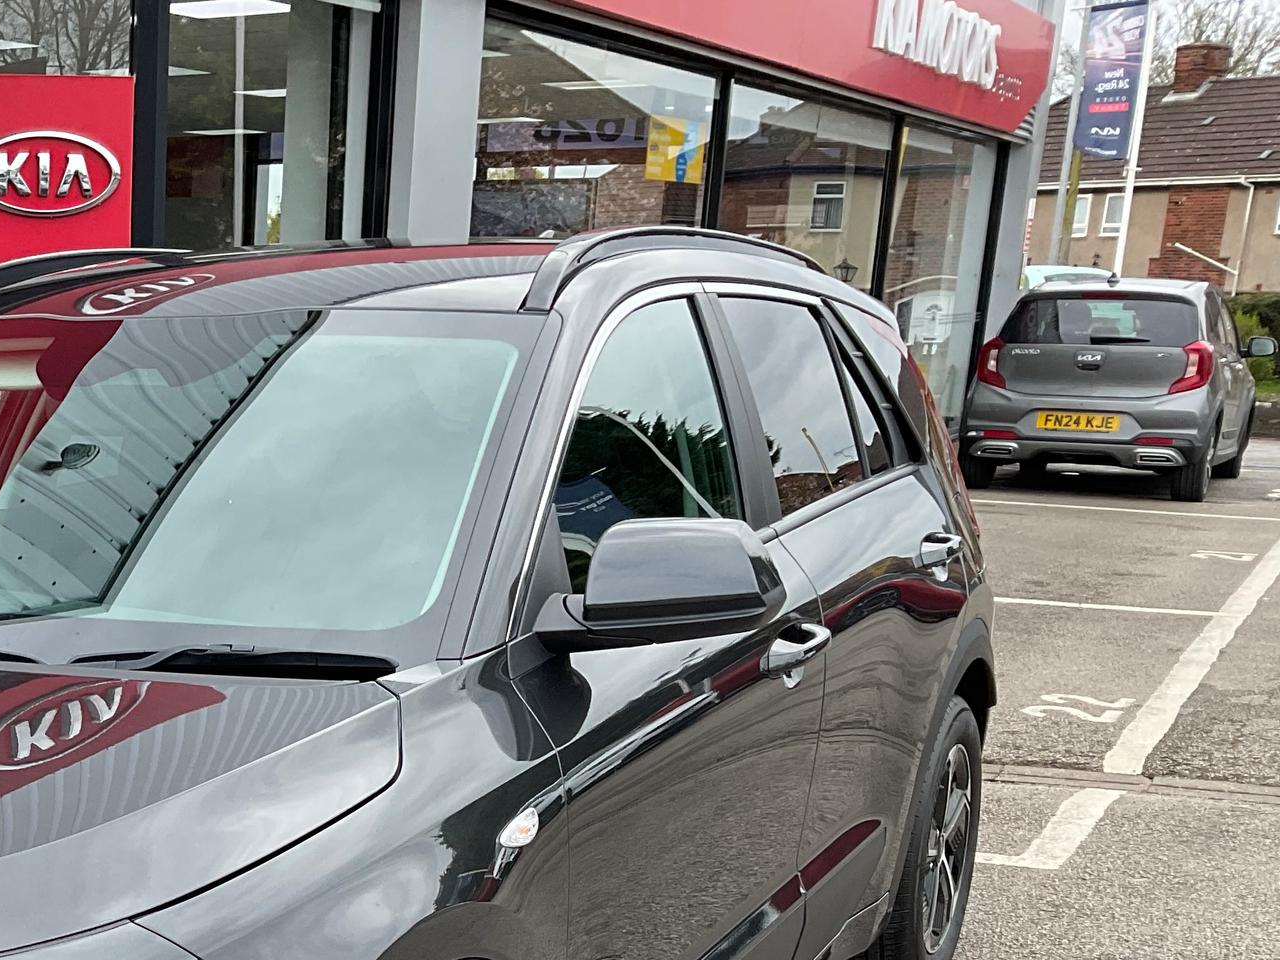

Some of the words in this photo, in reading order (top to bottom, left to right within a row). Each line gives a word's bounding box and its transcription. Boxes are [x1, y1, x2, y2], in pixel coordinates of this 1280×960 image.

[913, 0, 1003, 90] MOTORS
[1044, 414, 1081, 427] FN24
[1085, 415, 1115, 429] KJE
[1020, 693, 1137, 723] 22
